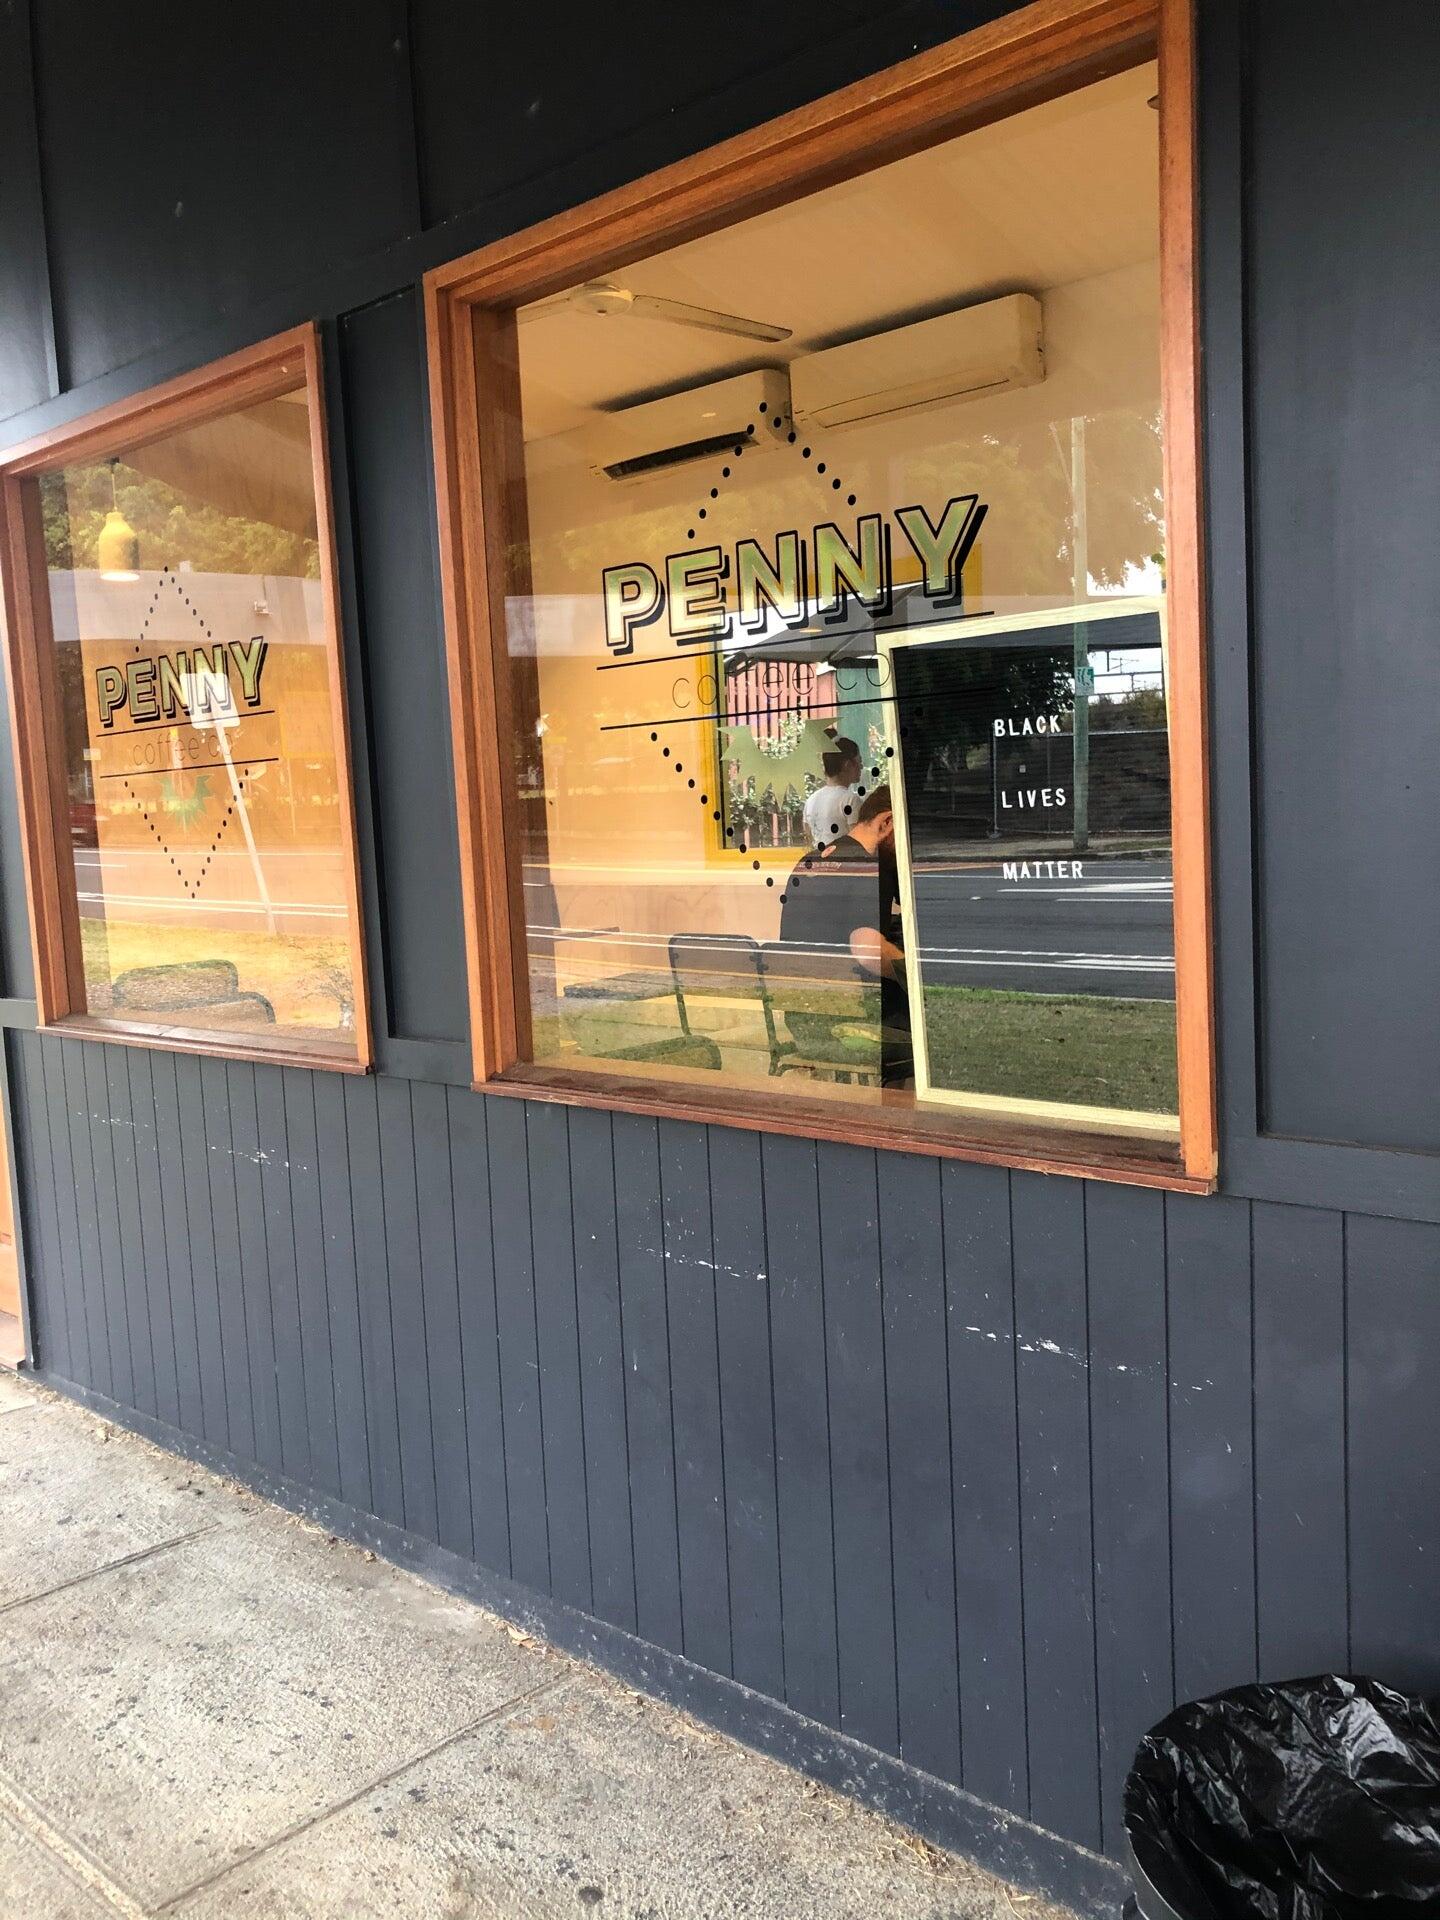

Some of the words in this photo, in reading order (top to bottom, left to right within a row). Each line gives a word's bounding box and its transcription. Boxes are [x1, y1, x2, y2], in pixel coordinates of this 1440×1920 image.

[602, 494, 988, 655] PENNY
[96, 636, 268, 728] PENNY
[672, 656, 814, 709] coffee
[836, 653, 890, 690] co
[994, 715, 1061, 736] BLACK
[133, 732, 199, 766] coffee
[1002, 788, 1066, 808] LIVES
[1003, 861, 1083, 881] MATTER
